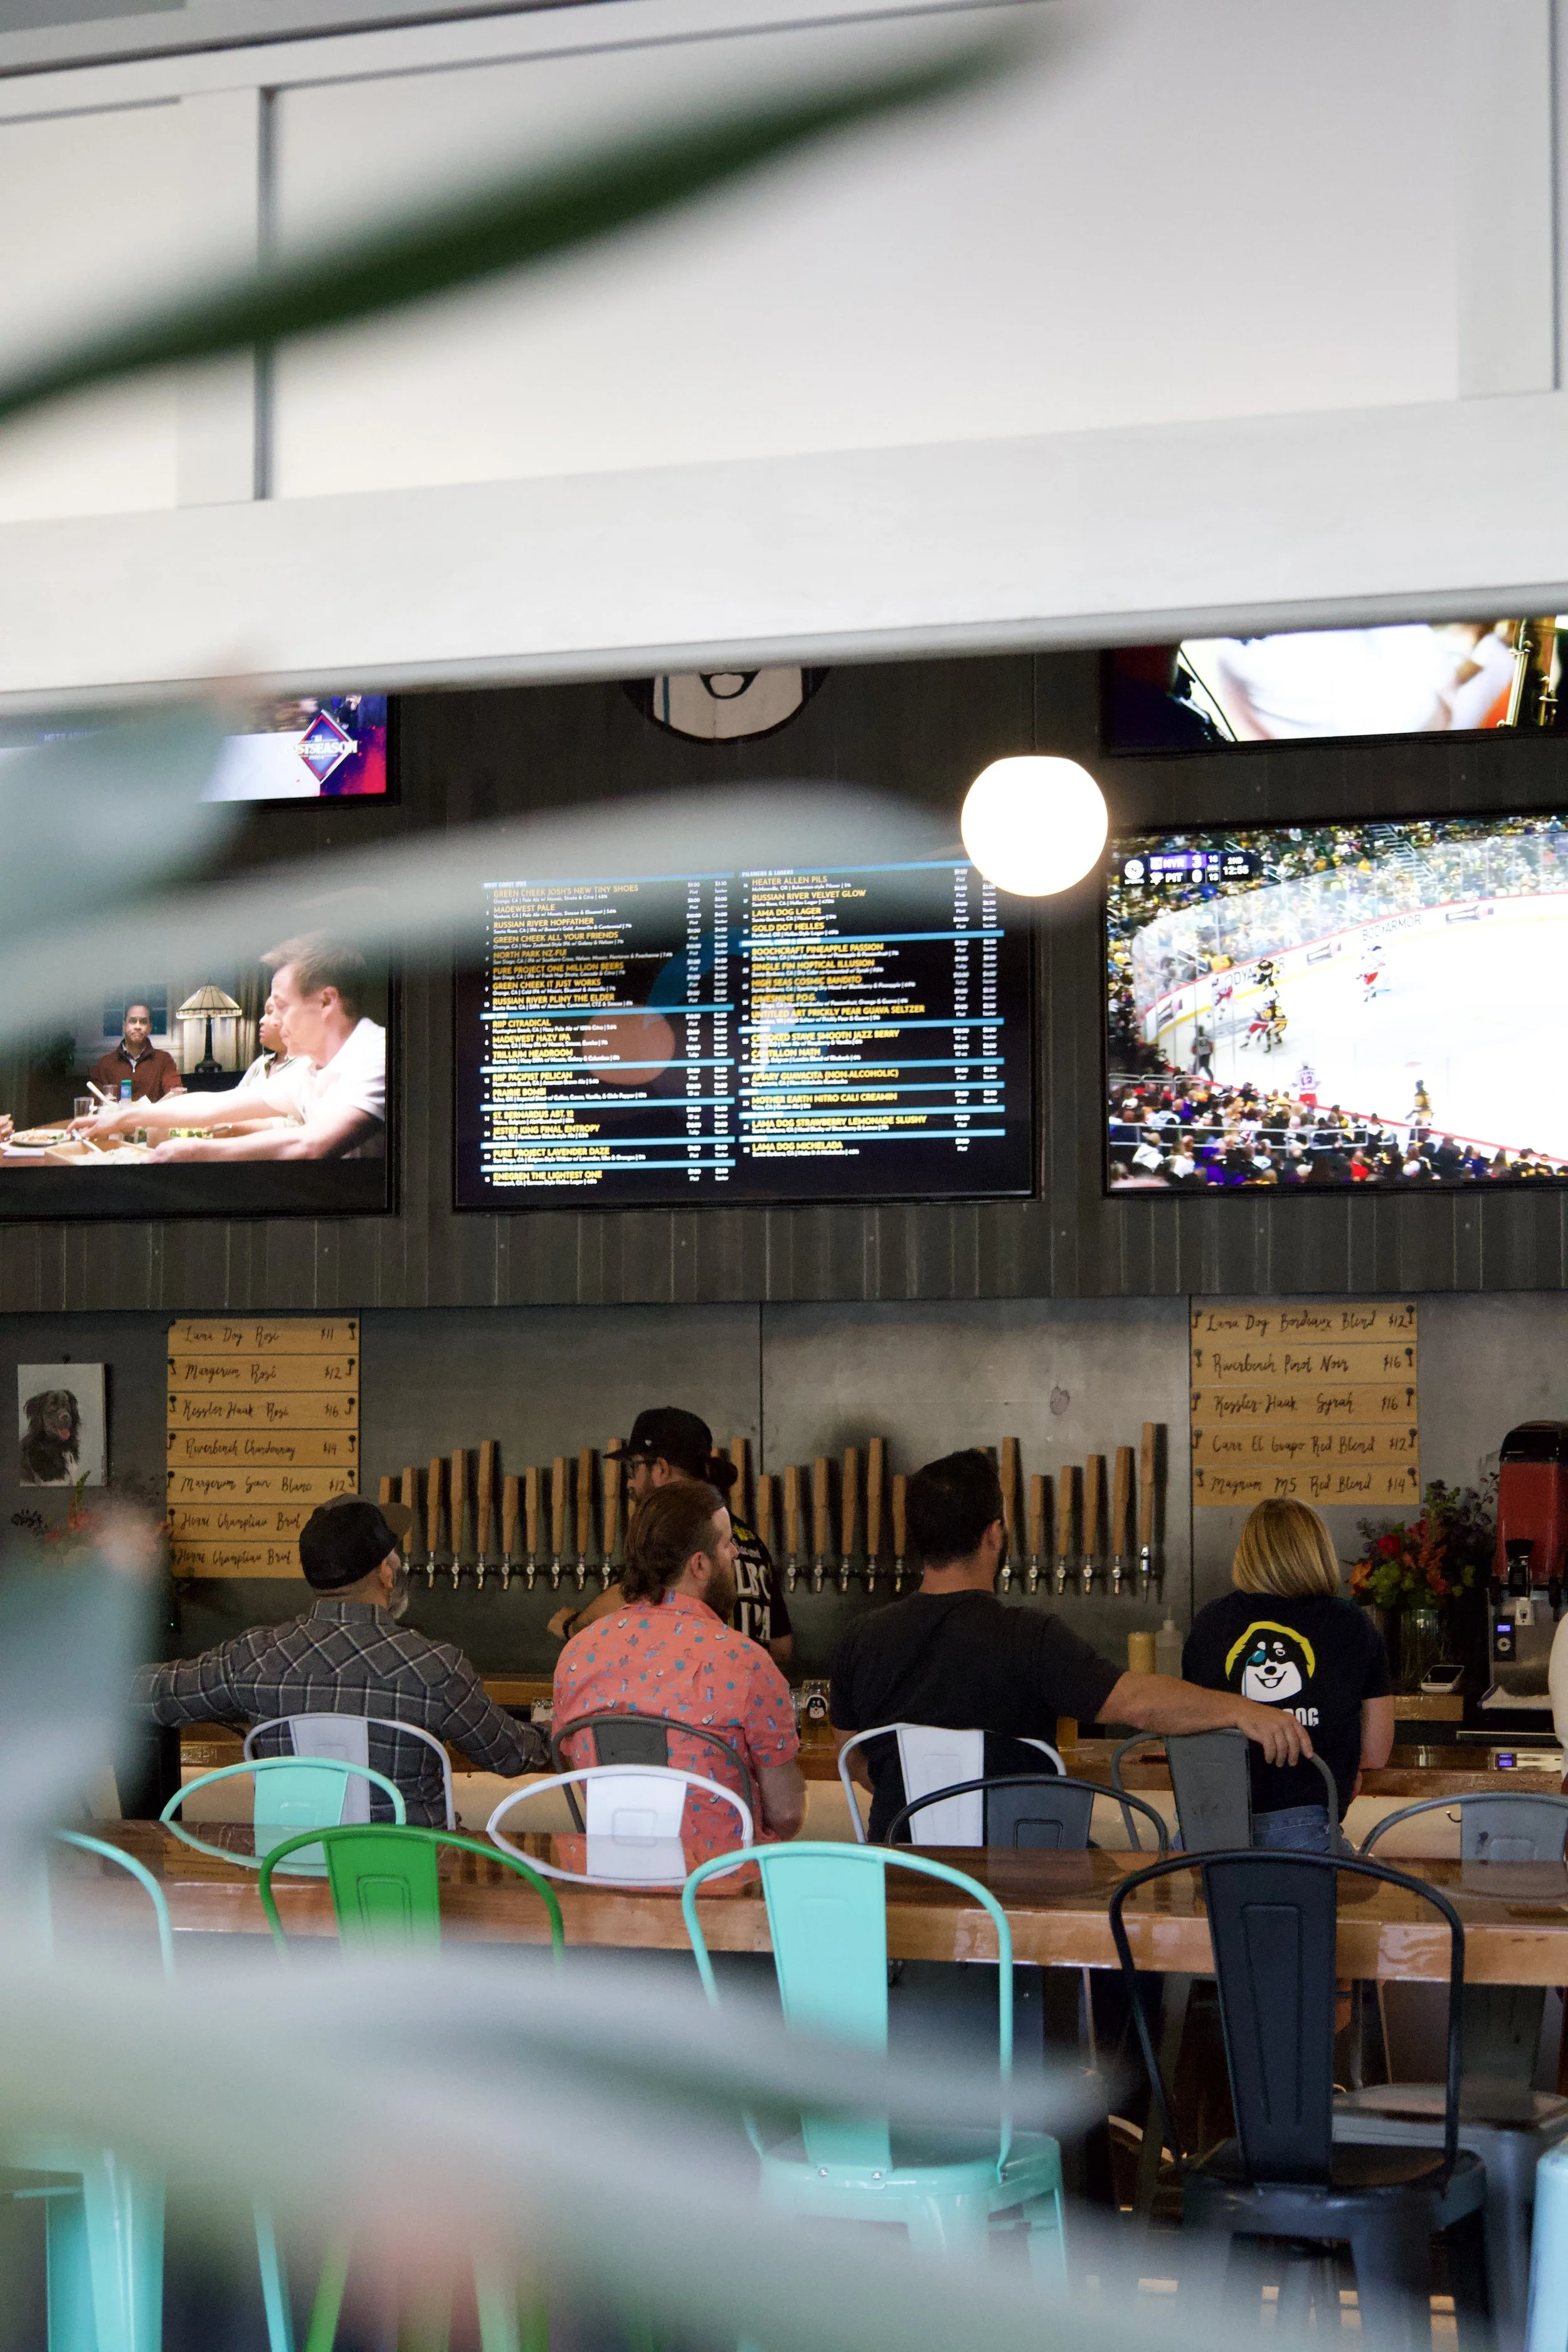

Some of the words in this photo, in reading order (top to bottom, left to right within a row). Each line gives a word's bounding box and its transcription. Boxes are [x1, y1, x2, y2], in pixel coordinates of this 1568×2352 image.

[1191, 854, 1202, 869] 3
[1165, 872, 1184, 883] PIT
[493, 889, 521, 898] GREEN
[521, 888, 546, 896] CHEEK
[548, 887, 572, 895] JOSH'S
[613, 884, 639, 893] SHOES
[751, 893, 785, 901] RUSSIAN
[786, 892, 810, 900] RIVER
[811, 891, 840, 899] VELVET
[841, 889, 866, 898] GLOW
[493, 904, 536, 913] MADEWEST
[795, 907, 822, 915] LAGER
[493, 920, 525, 928] RUSSIAN
[526, 919, 549, 927] RIVER
[549, 917, 595, 926] HOPFATHER
[751, 924, 775, 932] GOLD
[776, 923, 793, 931] DOT
[794, 921, 825, 930] HELLES
[1362, 914, 1422, 941] BODYARMOR
[493, 935, 519, 944] GREEN
[519, 934, 546, 943] CHEEK
[547, 933, 562, 941] ALL
[563, 933, 585, 941] YOUR
[586, 931, 619, 940] FRIENDS
[849, 943, 884, 952] PASSION
[492, 950, 520, 959] NORTH
[521, 950, 540, 958] PARK
[492, 967, 512, 975] PURE
[513, 965, 544, 974] PROJECT
[546, 964, 564, 972] ONE
[492, 981, 518, 990] GREEN
[519, 980, 546, 989] CHEEK
[546, 980, 554, 988] IT
[554, 979, 572, 988] JUST
[573, 978, 601, 987] WORKS
[492, 996, 524, 1005] RUSSIAN
[526, 995, 548, 1004] RIVER
[549, 994, 572, 1003] PLINY
[572, 993, 588, 1002] THE
[590, 993, 615, 1002] ELDER
[791, 1009, 806, 1017] ART
[840, 1007, 862, 1015] PEAR
[862, 1005, 890, 1015] GUAVA
[891, 1004, 926, 1014] SELTZER
[507, 1019, 551, 1028] CITRADICAL
[492, 1034, 534, 1044] MADEWEST
[535, 1032, 558, 1042] HAZY
[558, 1032, 571, 1041] IPA
[492, 1049, 527, 1059] TRILLIUM
[528, 1047, 574, 1058] HEADROOM
[507, 1072, 539, 1081] PACIFIST
[539, 1071, 573, 1080] PELICAN
[492, 1087, 521, 1098] PRAIRIE
[503, 1110, 549, 1120] BERNARDUS
[751, 1120, 775, 1129] LAMA
[776, 1119, 795, 1128] DOG
[847, 1116, 894, 1126] LEMONADE
[895, 1115, 927, 1125] SLUSHY
[492, 1126, 519, 1135] JESTER
[519, 1125, 539, 1135] KING
[539, 1125, 563, 1134] FINAL
[563, 1123, 600, 1133] ENTROPY
[492, 1149, 512, 1158] PURE
[513, 1148, 546, 1158] PROJECT
[547, 1147, 588, 1157] LAVENDER
[588, 1147, 610, 1156] DAZE
[751, 1143, 775, 1152] LAMA
[776, 1142, 795, 1151] DOG
[796, 1141, 844, 1150] MICHELADA
[492, 1172, 530, 1182] ENEGREN
[531, 1172, 546, 1180] THE
[547, 1170, 583, 1180] LIGHTEST
[584, 1170, 603, 1179] ONE
[1245, 1314, 1270, 1337] Dog
[1341, 1310, 1376, 1331] Blend
[1389, 1316, 1409, 1328] $12
[1320, 1354, 1349, 1372] Noir
[1384, 1354, 1401, 1372] $16
[325, 1365, 342, 1380] $12
[1381, 1394, 1399, 1412] $16
[1310, 1435, 1333, 1457] Red
[1338, 1435, 1376, 1455] Blend
[1389, 1438, 1407, 1451] $12
[329, 1479, 347, 1492] $12
[1309, 1473, 1331, 1498] Red
[1335, 1472, 1372, 1494] Blend
[1387, 1476, 1406, 1494] $14
